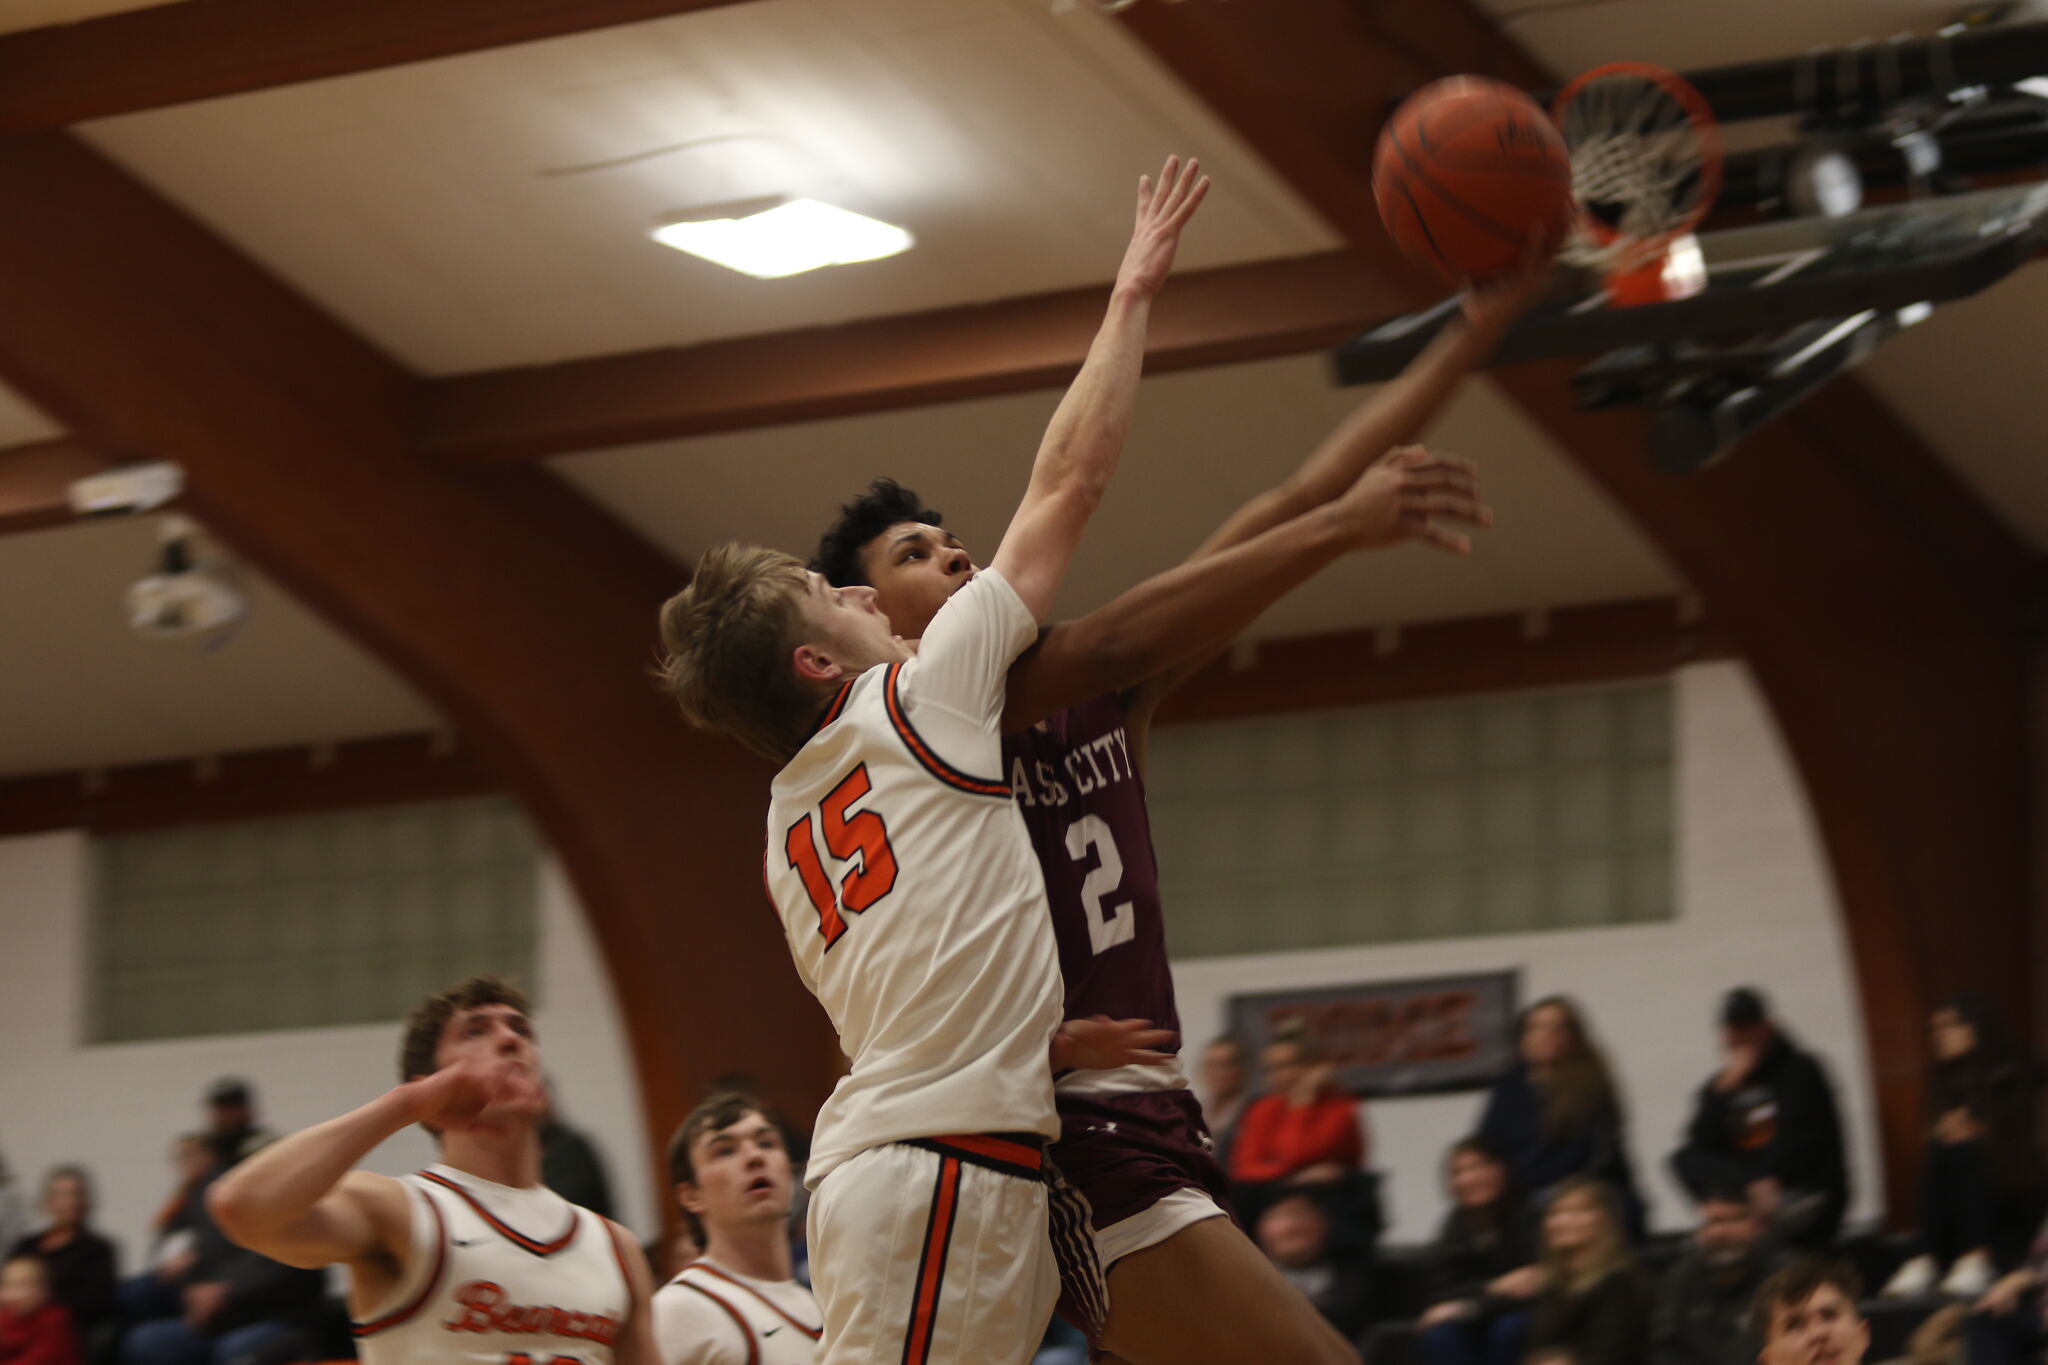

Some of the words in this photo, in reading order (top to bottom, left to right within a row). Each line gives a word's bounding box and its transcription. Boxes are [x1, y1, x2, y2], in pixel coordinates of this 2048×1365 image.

[1011, 756, 1069, 807] ASS
[1064, 726, 1132, 796] CITY
[785, 760, 899, 954] 15
[1064, 813, 1135, 956] 2
